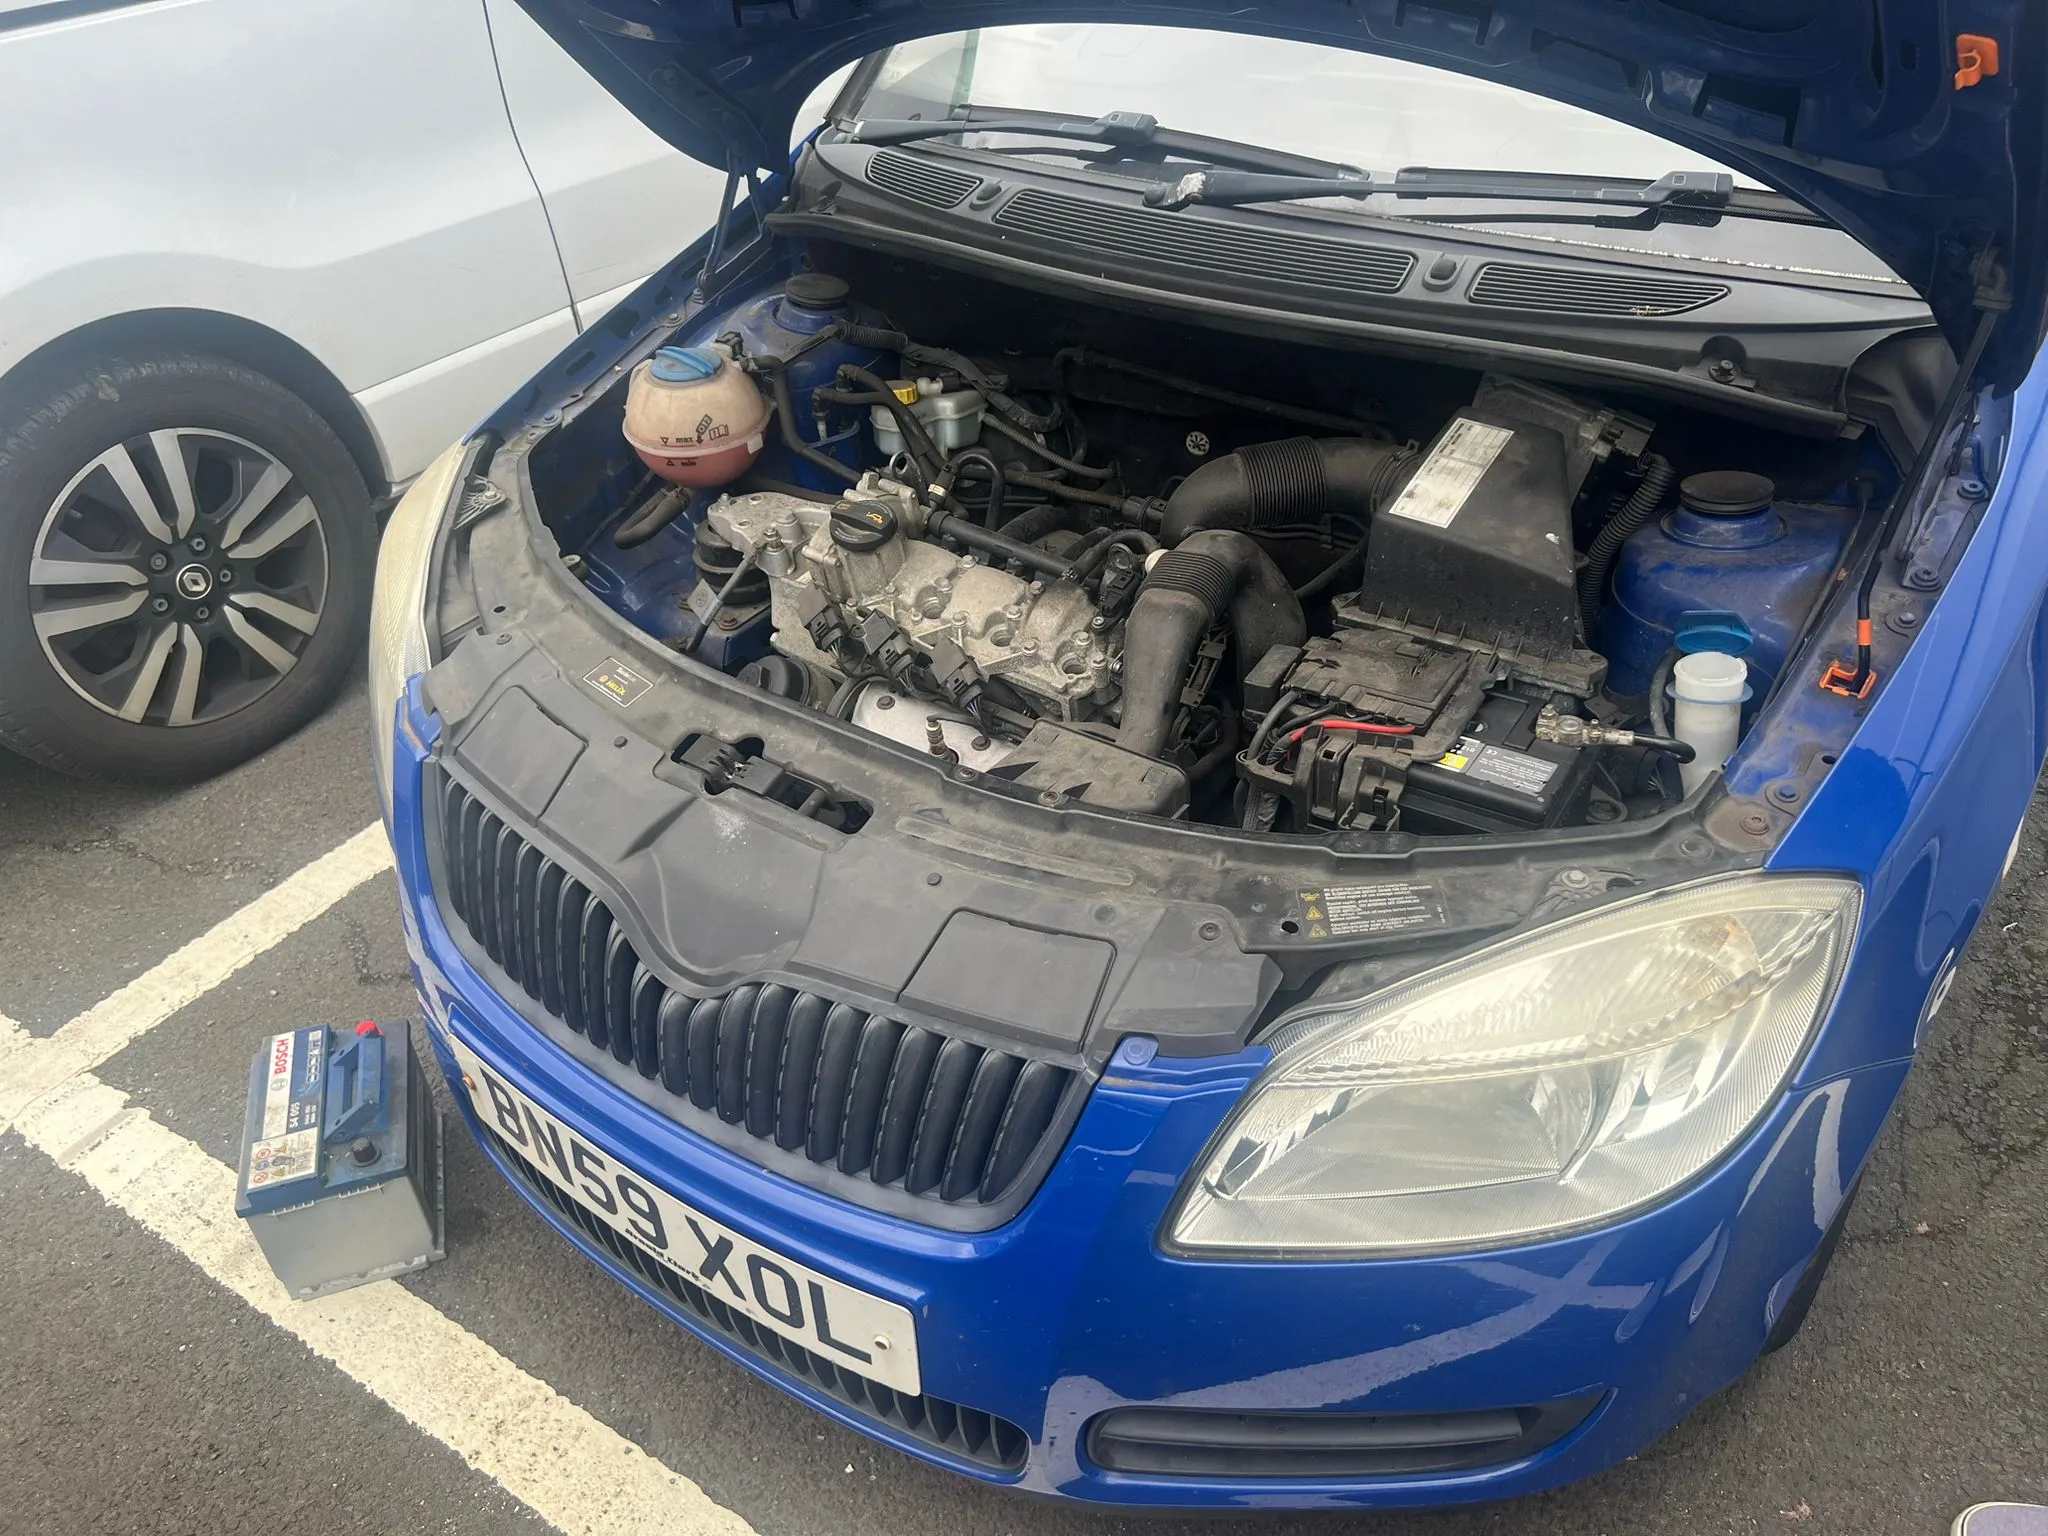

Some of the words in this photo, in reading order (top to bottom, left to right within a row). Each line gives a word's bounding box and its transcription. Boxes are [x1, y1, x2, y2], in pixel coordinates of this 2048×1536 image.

[274, 1039, 289, 1075] BOSCH
[478, 1065, 668, 1251] BN59
[684, 1212, 873, 1365] XOL
[625, 1228, 665, 1258] Arnold
